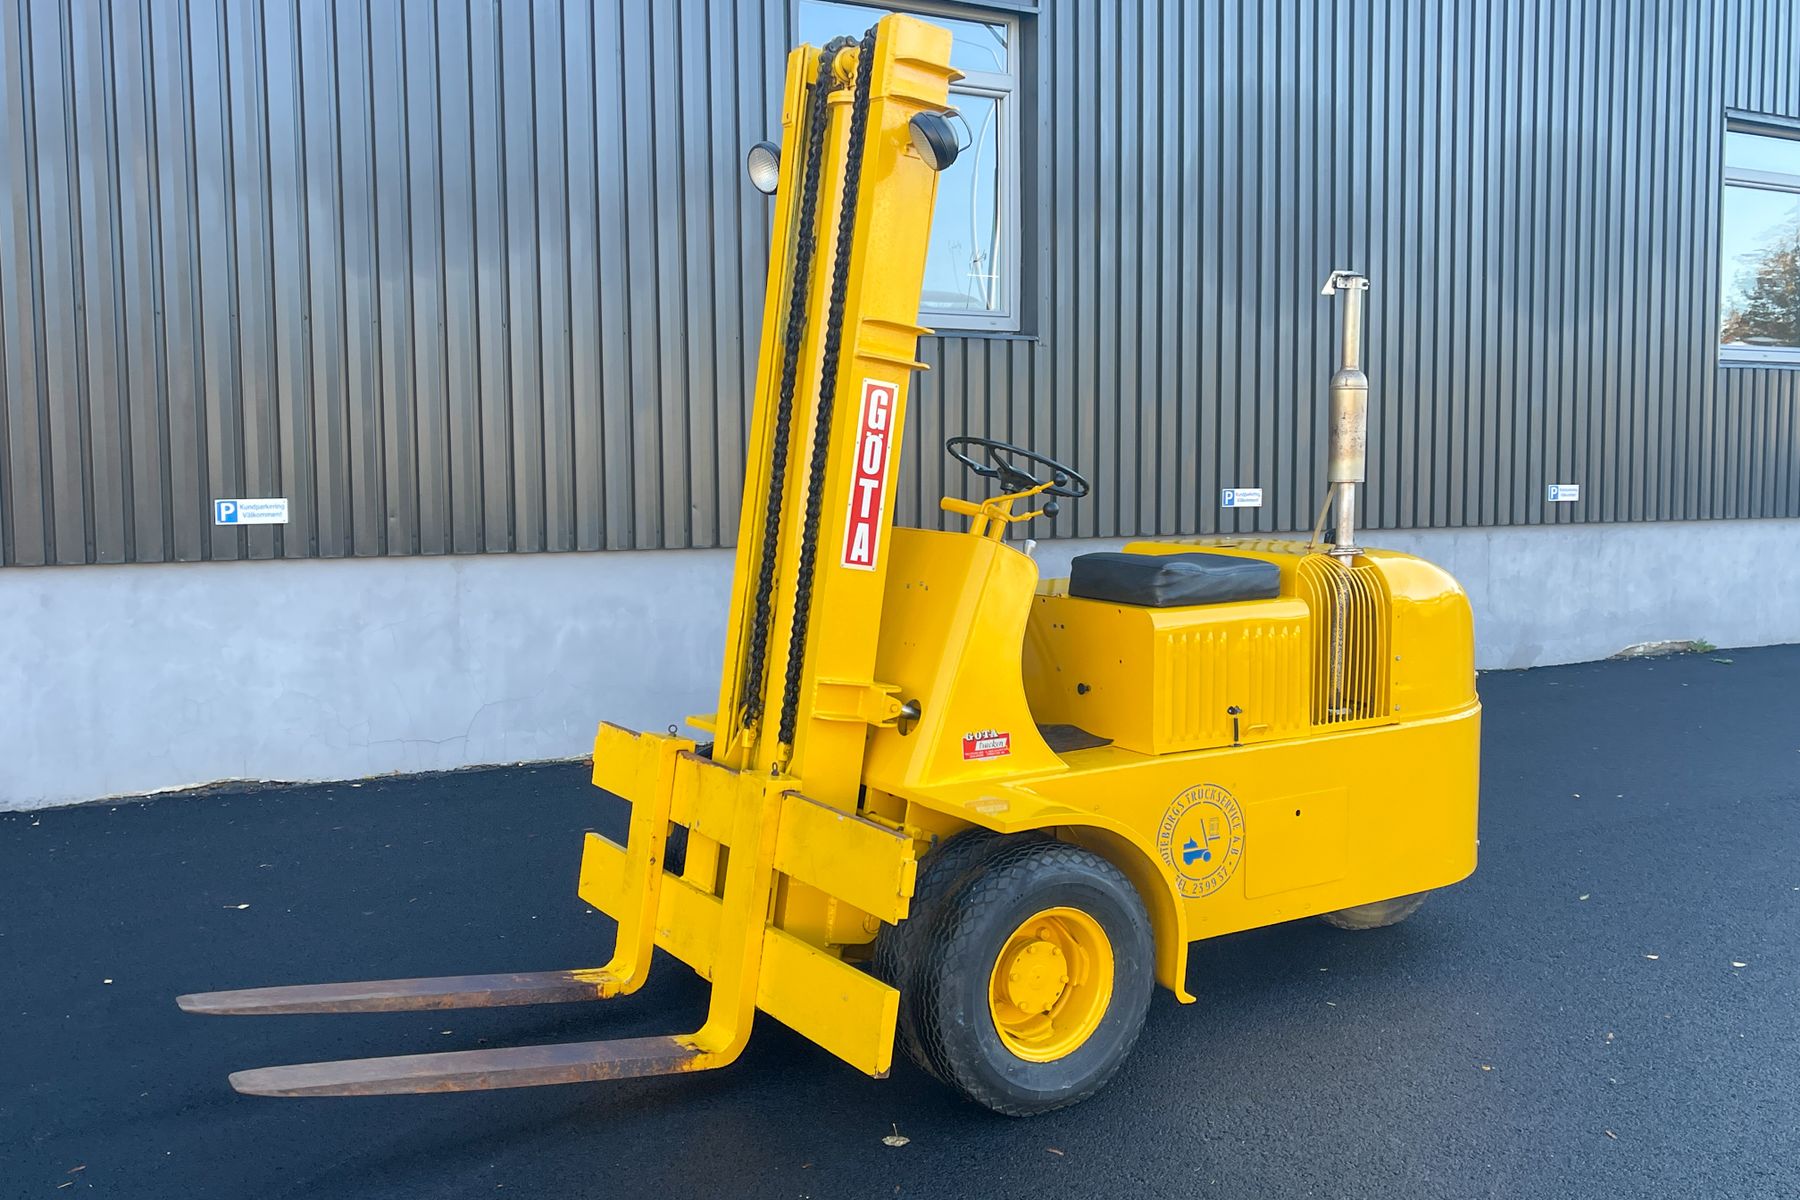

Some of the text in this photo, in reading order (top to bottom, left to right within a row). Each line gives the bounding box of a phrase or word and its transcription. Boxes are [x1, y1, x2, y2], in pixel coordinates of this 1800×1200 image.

[850, 389, 889, 562] GÖTA
[1225, 491, 1233, 504] P
[1551, 487, 1557, 499] P
[221, 503, 235, 521] P
[1185, 788, 1241, 830] TRUCKSERVICE
